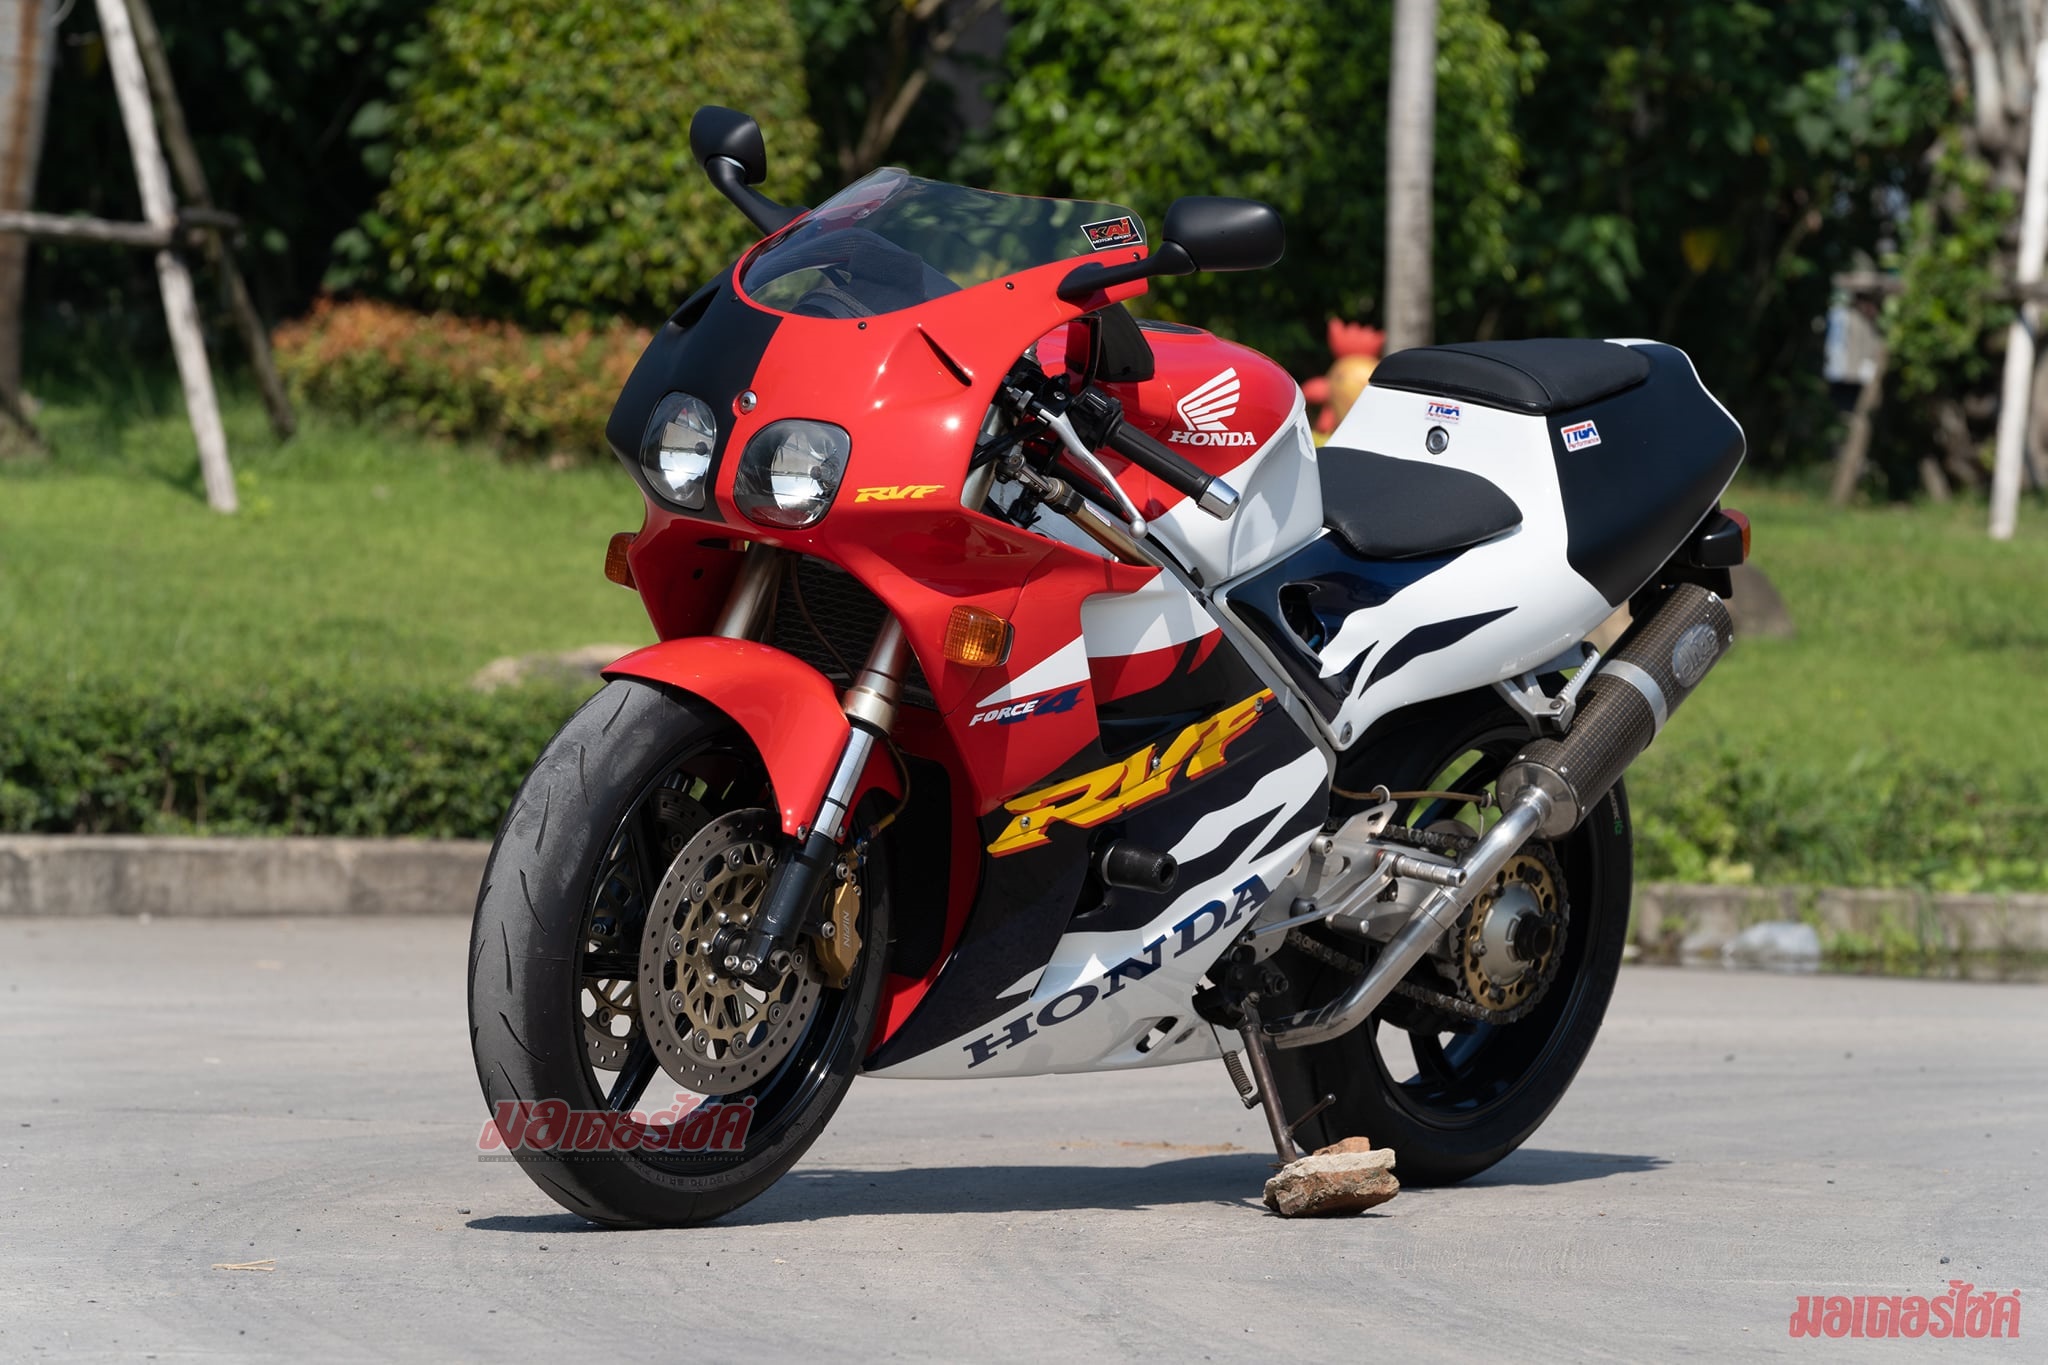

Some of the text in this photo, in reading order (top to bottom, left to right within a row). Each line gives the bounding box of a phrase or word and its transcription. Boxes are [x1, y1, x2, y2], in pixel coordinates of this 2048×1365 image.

[1113, 233, 1132, 241] SPORT
[1168, 430, 1257, 447] HONDA
[854, 485, 945, 503] RVF
[968, 699, 1040, 727] FORCE
[987, 687, 1277, 857] RVF
[963, 874, 1274, 1069] HONDA
